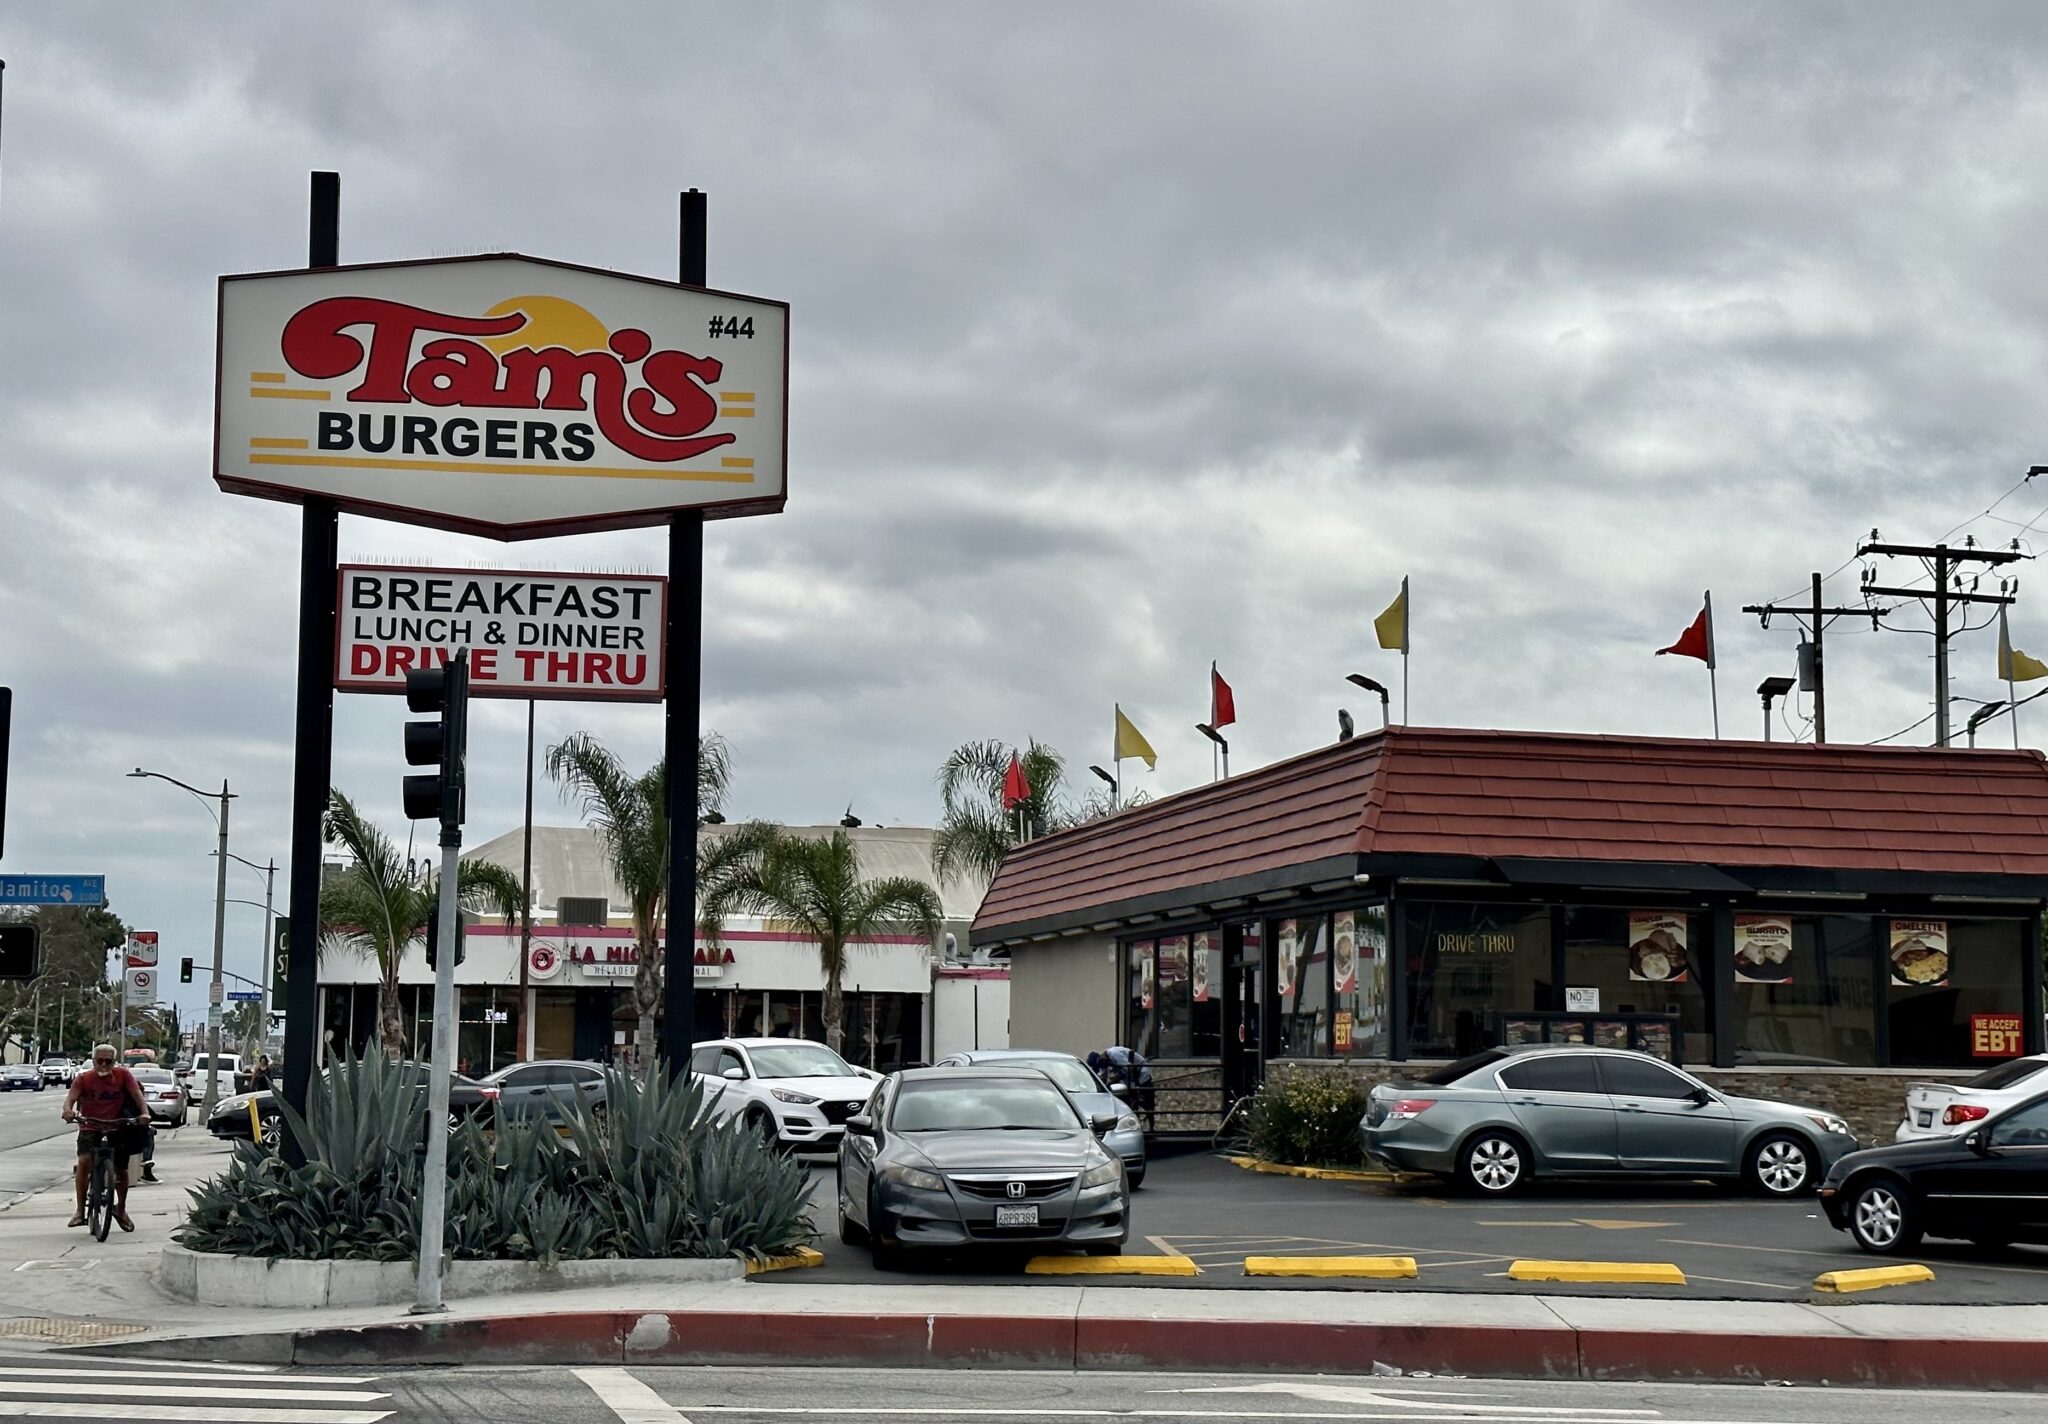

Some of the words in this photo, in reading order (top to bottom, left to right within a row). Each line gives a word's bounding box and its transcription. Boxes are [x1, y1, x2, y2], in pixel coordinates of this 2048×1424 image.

[708, 315, 755, 340] #44
[281, 296, 736, 462] Tam's
[317, 411, 596, 462] BURGERS
[351, 576, 651, 620] BREAKFAST
[354, 616, 472, 644] LUNCH
[484, 621, 506, 646] &
[518, 622, 645, 650] DINNER
[515, 650, 647, 686] THRU
[1746, 927, 1789, 935] BURRITO
[1895, 922, 1943, 931] OMELETTE
[1438, 934, 1476, 953] DRIVE
[1481, 934, 1515, 953] THRU
[570, 946, 595, 964] LA
[607, 946, 735, 964] MICANA
[594, 966, 635, 976] HELADER
[1570, 992, 1581, 1001] NO
[1335, 1024, 1351, 1045] EBT
[1974, 1019, 1987, 1029] WE
[1989, 1019, 2019, 1030] ACCEPT
[1975, 1030, 2020, 1053] EBT
